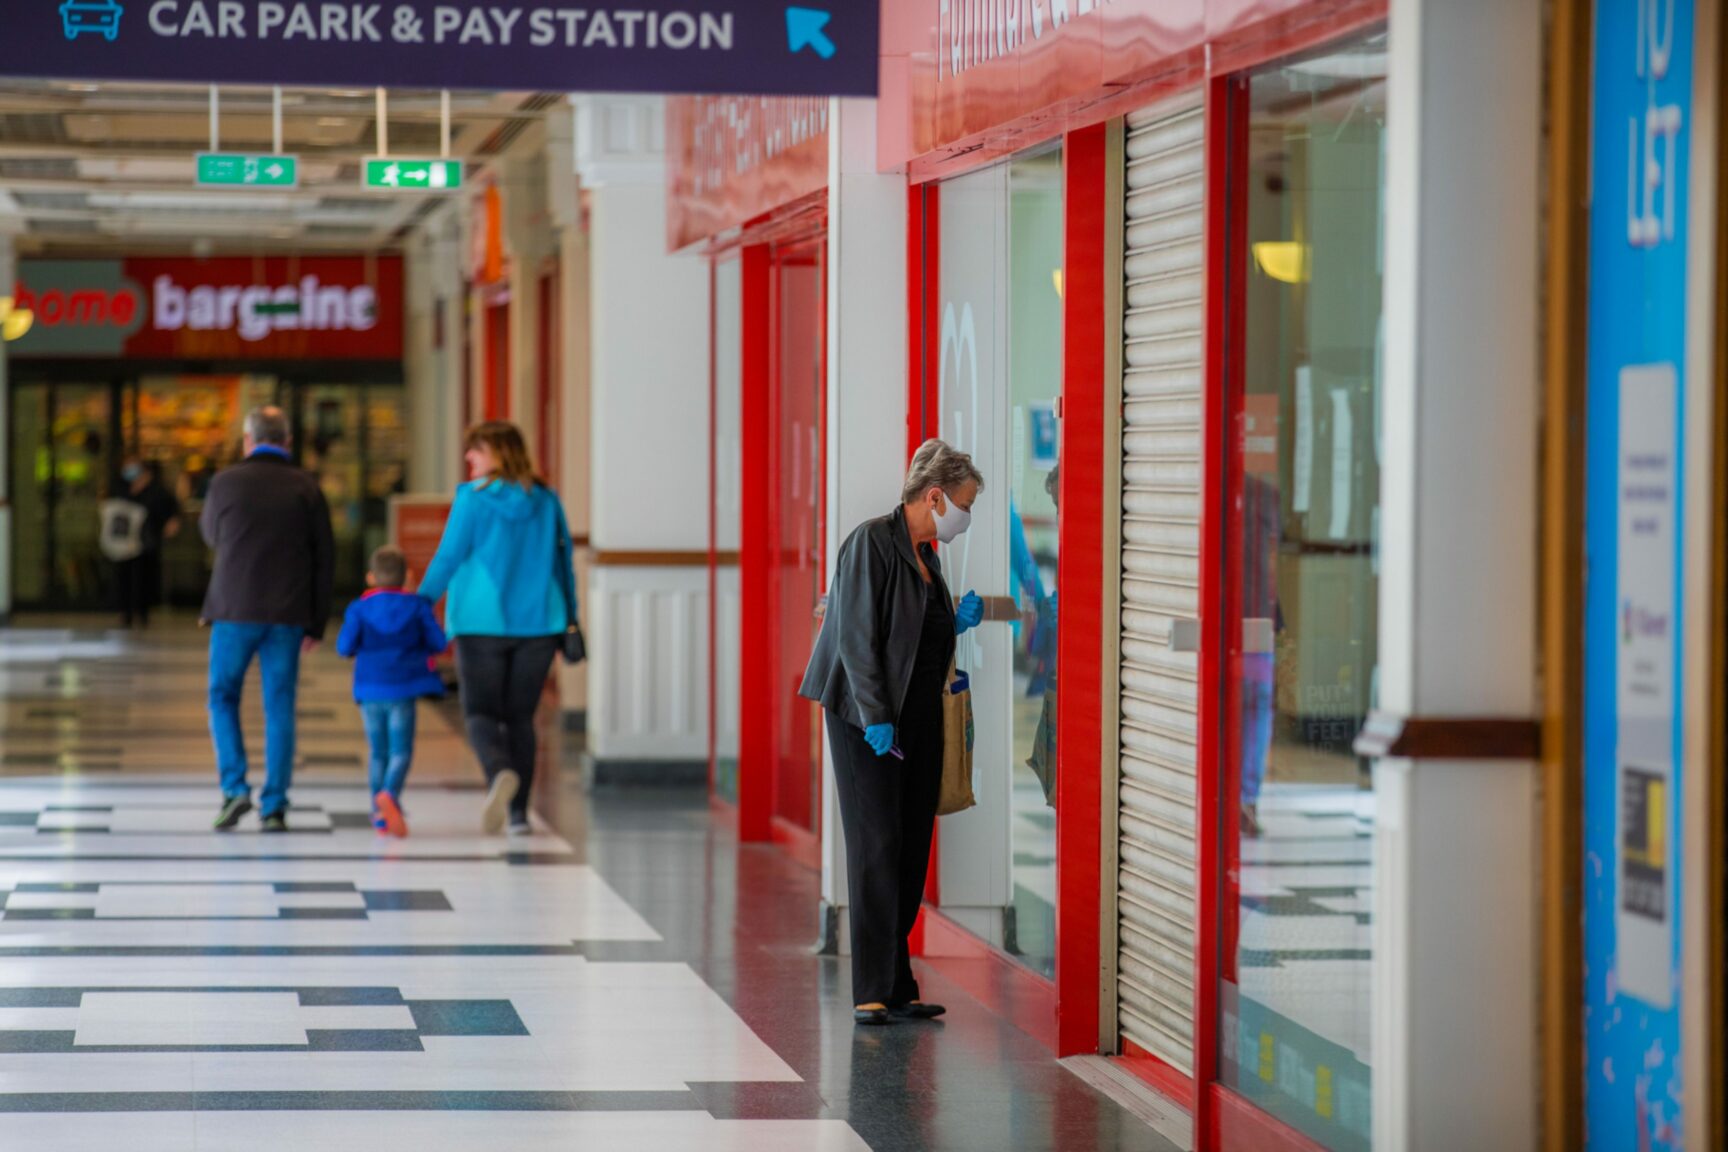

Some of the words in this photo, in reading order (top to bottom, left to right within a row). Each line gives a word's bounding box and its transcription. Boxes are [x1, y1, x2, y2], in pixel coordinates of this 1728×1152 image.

[148, 0, 247, 38] CAR
[257, 2, 382, 42] PARK
[390, 5, 424, 43] &
[434, 6, 522, 45] PAY
[529, 9, 733, 49] STATION
[1306, 685, 1344, 703] PUT
[1308, 722, 1349, 740] FEET
